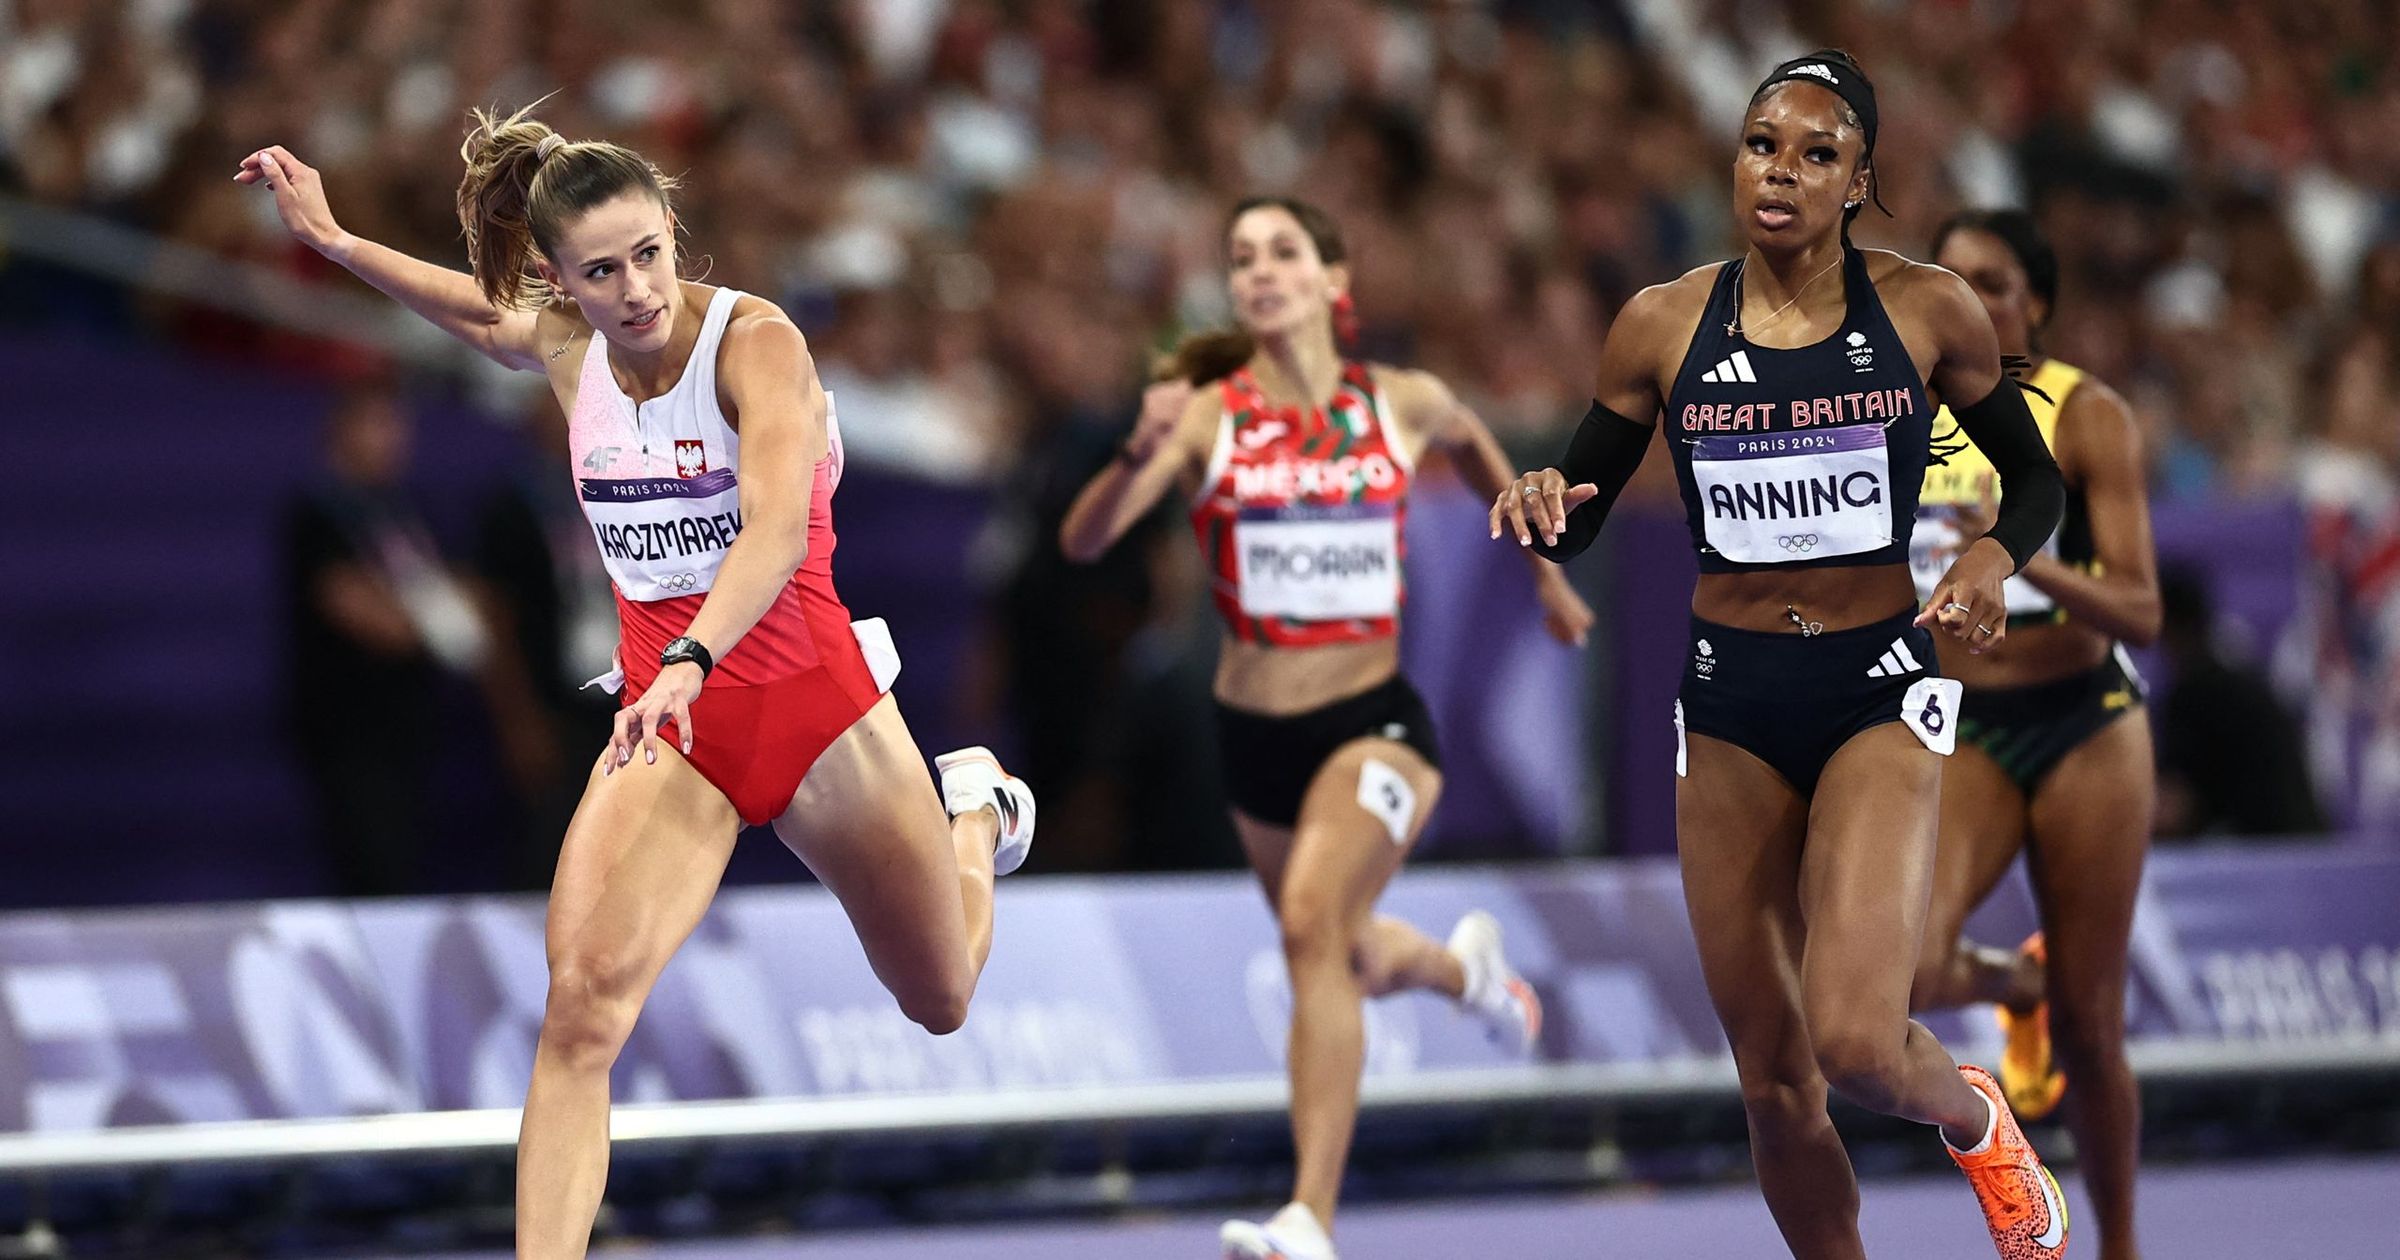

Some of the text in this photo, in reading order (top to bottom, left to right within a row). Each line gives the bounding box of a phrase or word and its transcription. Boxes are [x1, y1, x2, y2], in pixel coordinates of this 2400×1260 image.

[1846, 348, 1863, 356] TEAM
[1682, 387, 1914, 431] GREAT BRITAIN
[1738, 435, 1835, 453] PARIS 2024
[583, 446, 622, 473] 4F
[612, 483, 690, 496] PARIS 2024
[1709, 471, 1881, 520] ANNING
[1920, 693, 1944, 737] 6
